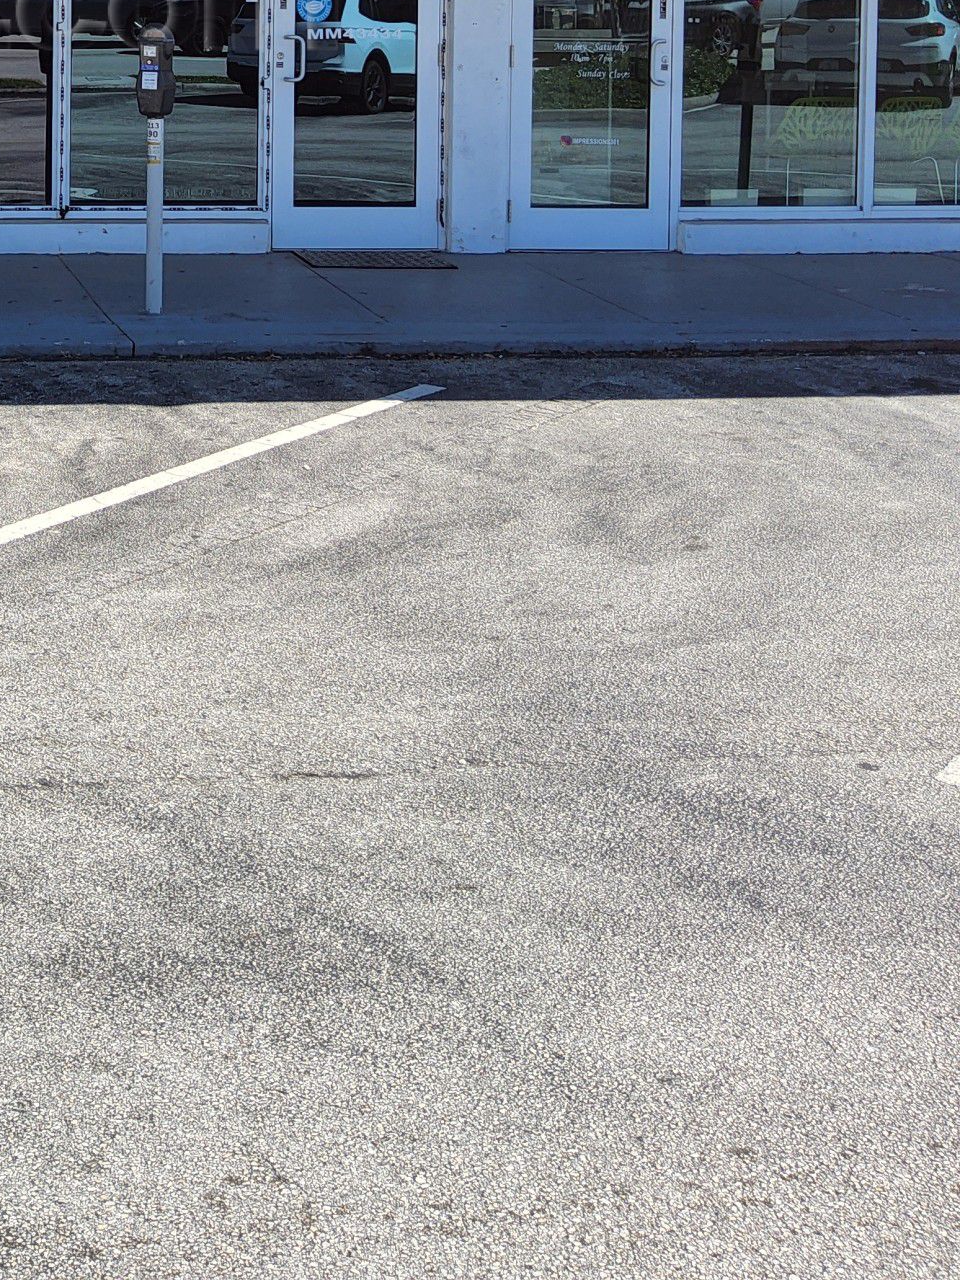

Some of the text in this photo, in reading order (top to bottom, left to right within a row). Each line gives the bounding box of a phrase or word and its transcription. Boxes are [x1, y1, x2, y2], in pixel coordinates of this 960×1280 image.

[554, 42, 589, 53] Monday
[593, 42, 630, 53] Saturday
[576, 67, 607, 79] Sunday
